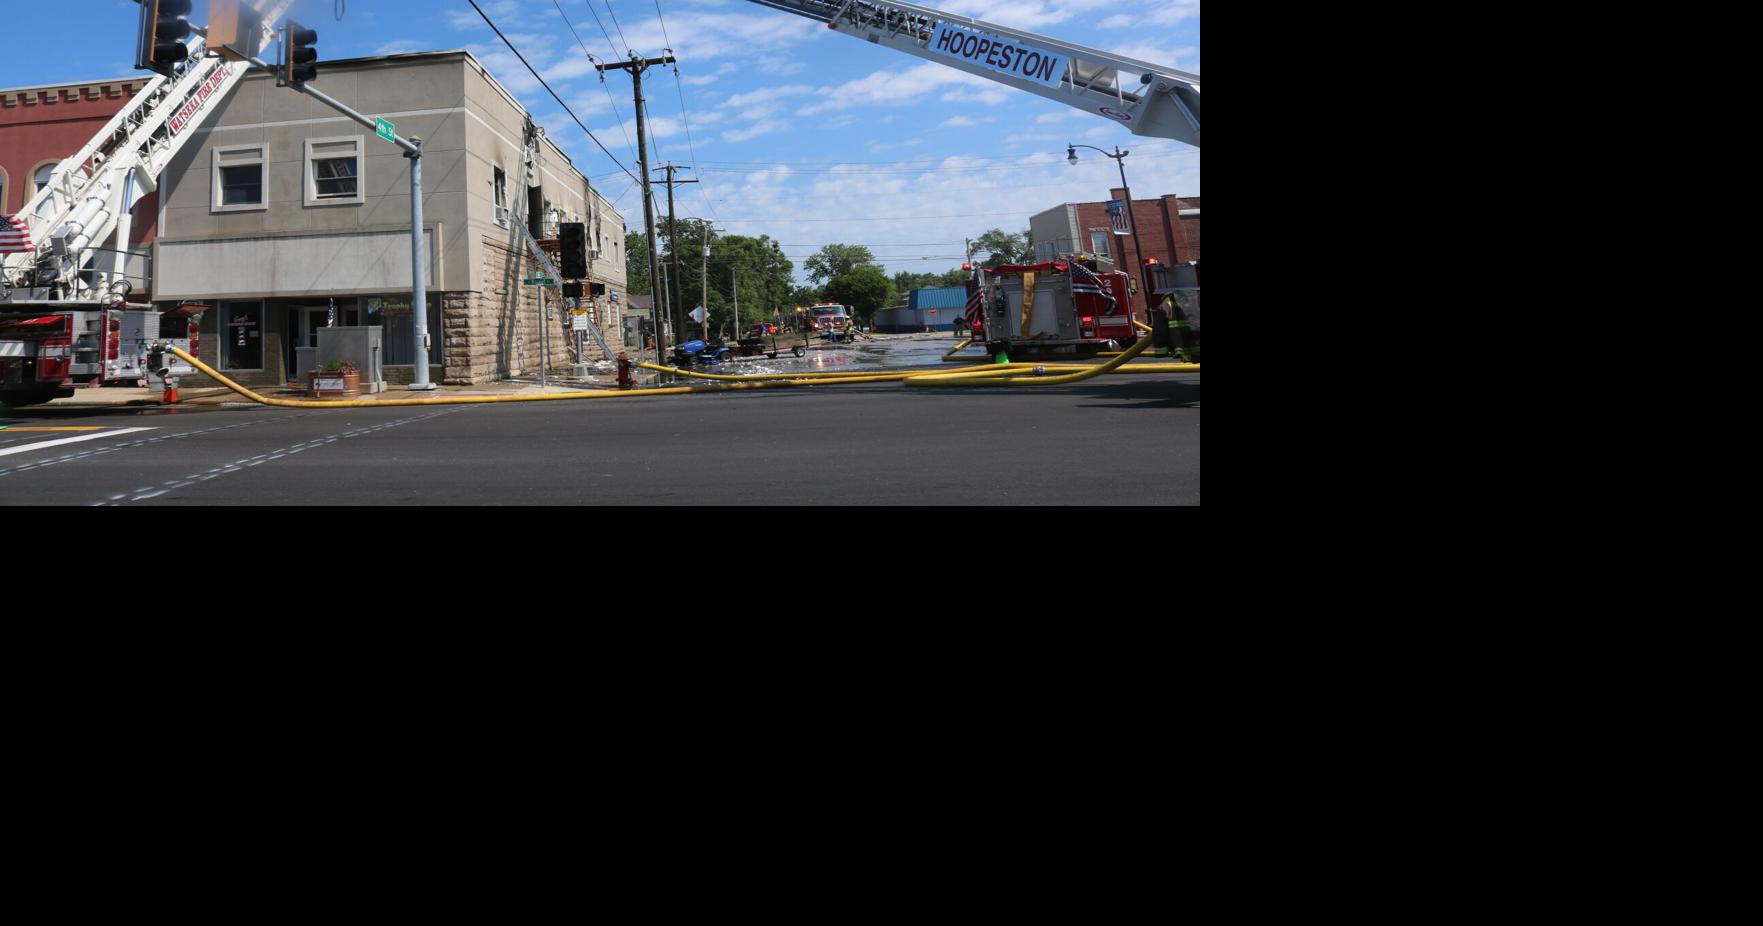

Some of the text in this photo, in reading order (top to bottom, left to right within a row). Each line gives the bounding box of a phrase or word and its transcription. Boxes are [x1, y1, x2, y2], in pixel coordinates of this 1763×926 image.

[937, 29, 1057, 81] HOOPESTON
[170, 97, 200, 131] WATSEKA
[196, 82, 213, 103] FIRE
